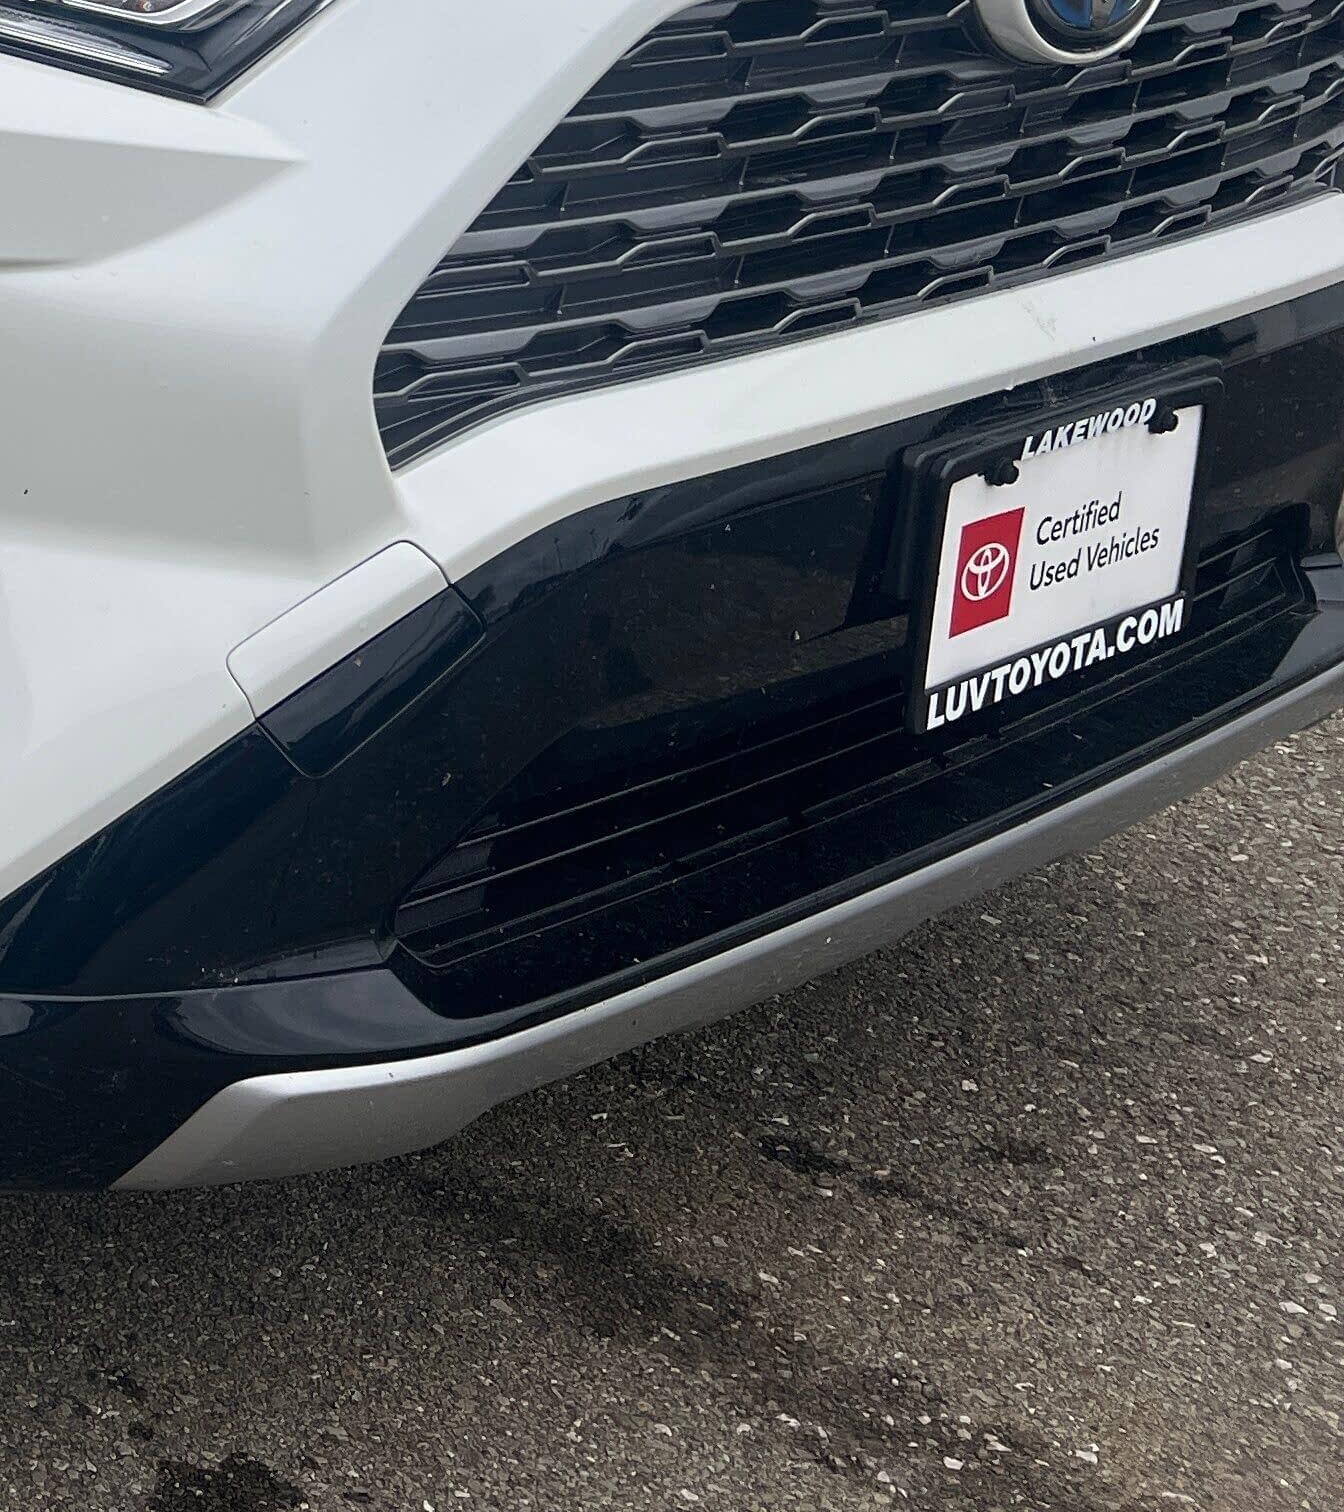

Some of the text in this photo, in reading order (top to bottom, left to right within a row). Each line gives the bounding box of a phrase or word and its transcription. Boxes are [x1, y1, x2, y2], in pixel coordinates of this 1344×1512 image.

[1021, 398, 1157, 461] LAKEWOOD
[1036, 490, 1123, 546] Certified
[1029, 526, 1161, 591] Used Vehicles
[926, 598, 1186, 731] LUVTOYOTA.COM
